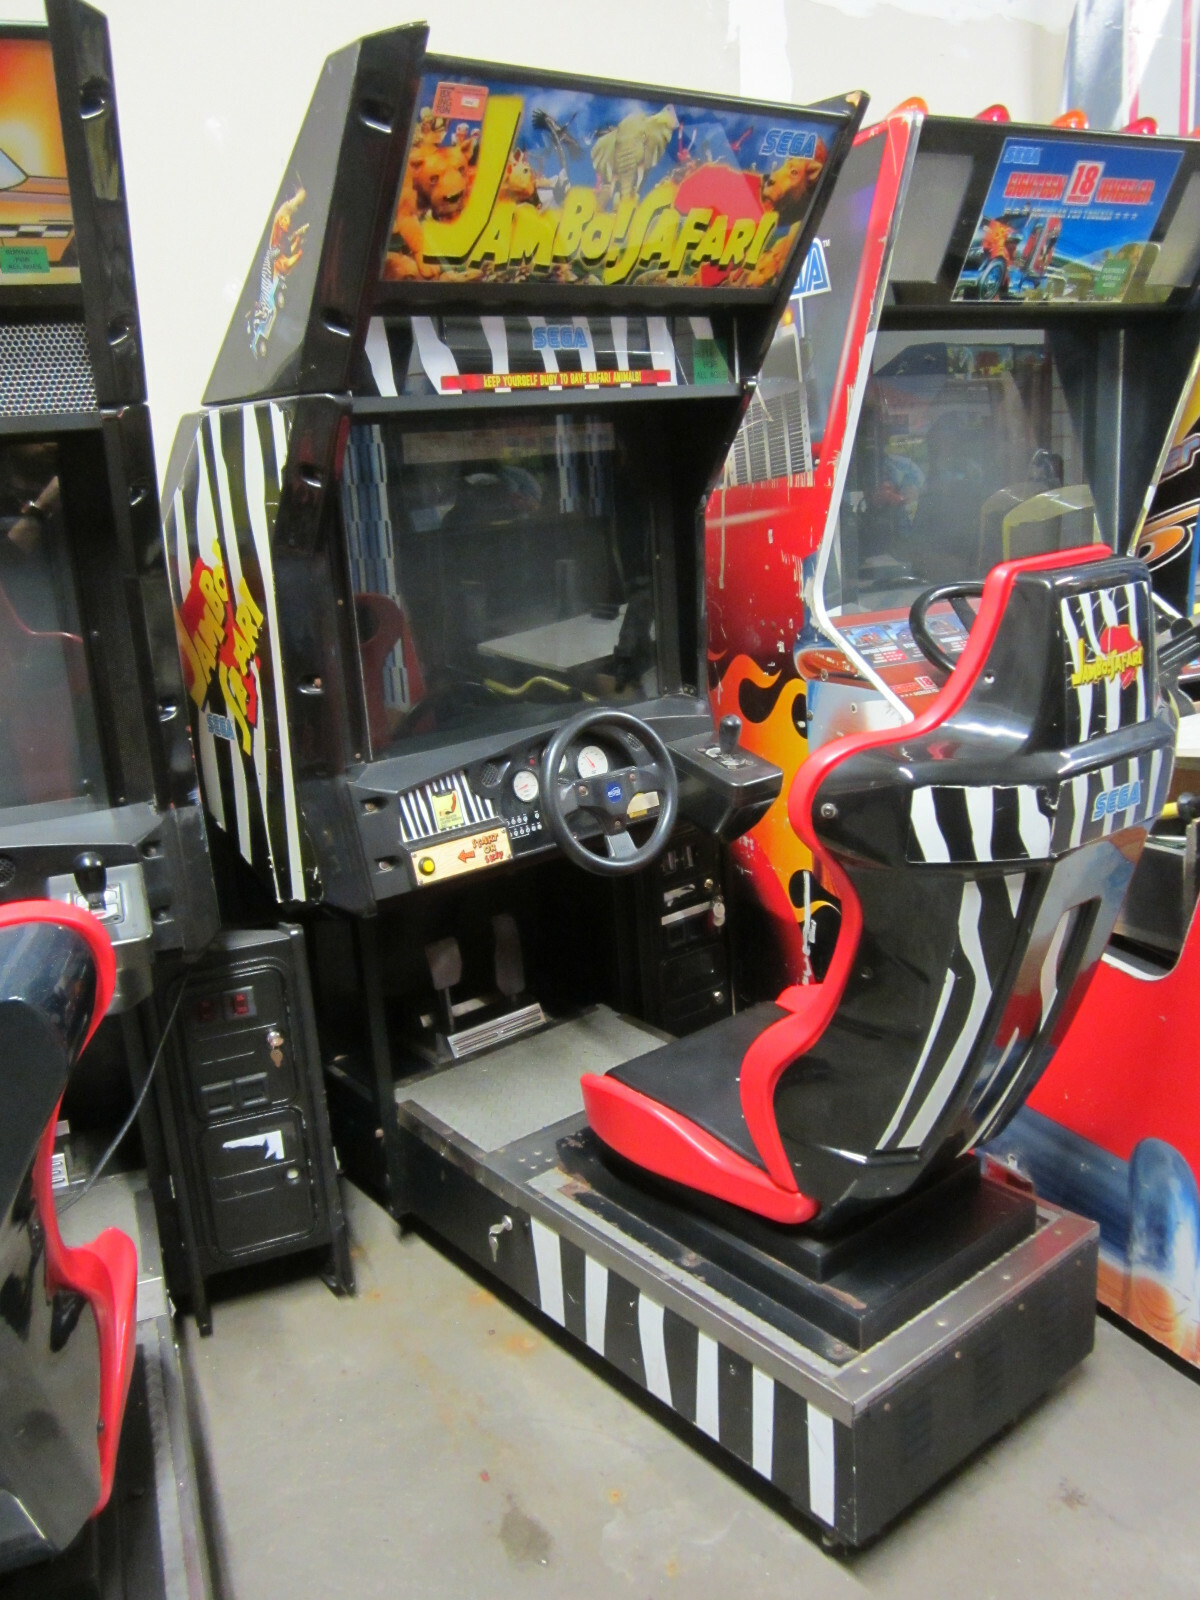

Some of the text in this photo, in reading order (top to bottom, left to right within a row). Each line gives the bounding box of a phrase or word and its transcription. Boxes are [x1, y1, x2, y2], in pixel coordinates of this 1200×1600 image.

[759, 128, 817, 160] SEGA
[1002, 145, 1042, 165] SEGA
[1071, 165, 1099, 195] 18
[531, 325, 588, 351] SEGA
[560, 373, 568, 385] TO
[206, 712, 235, 741] SEGA
[1091, 781, 1142, 822] SEGA
